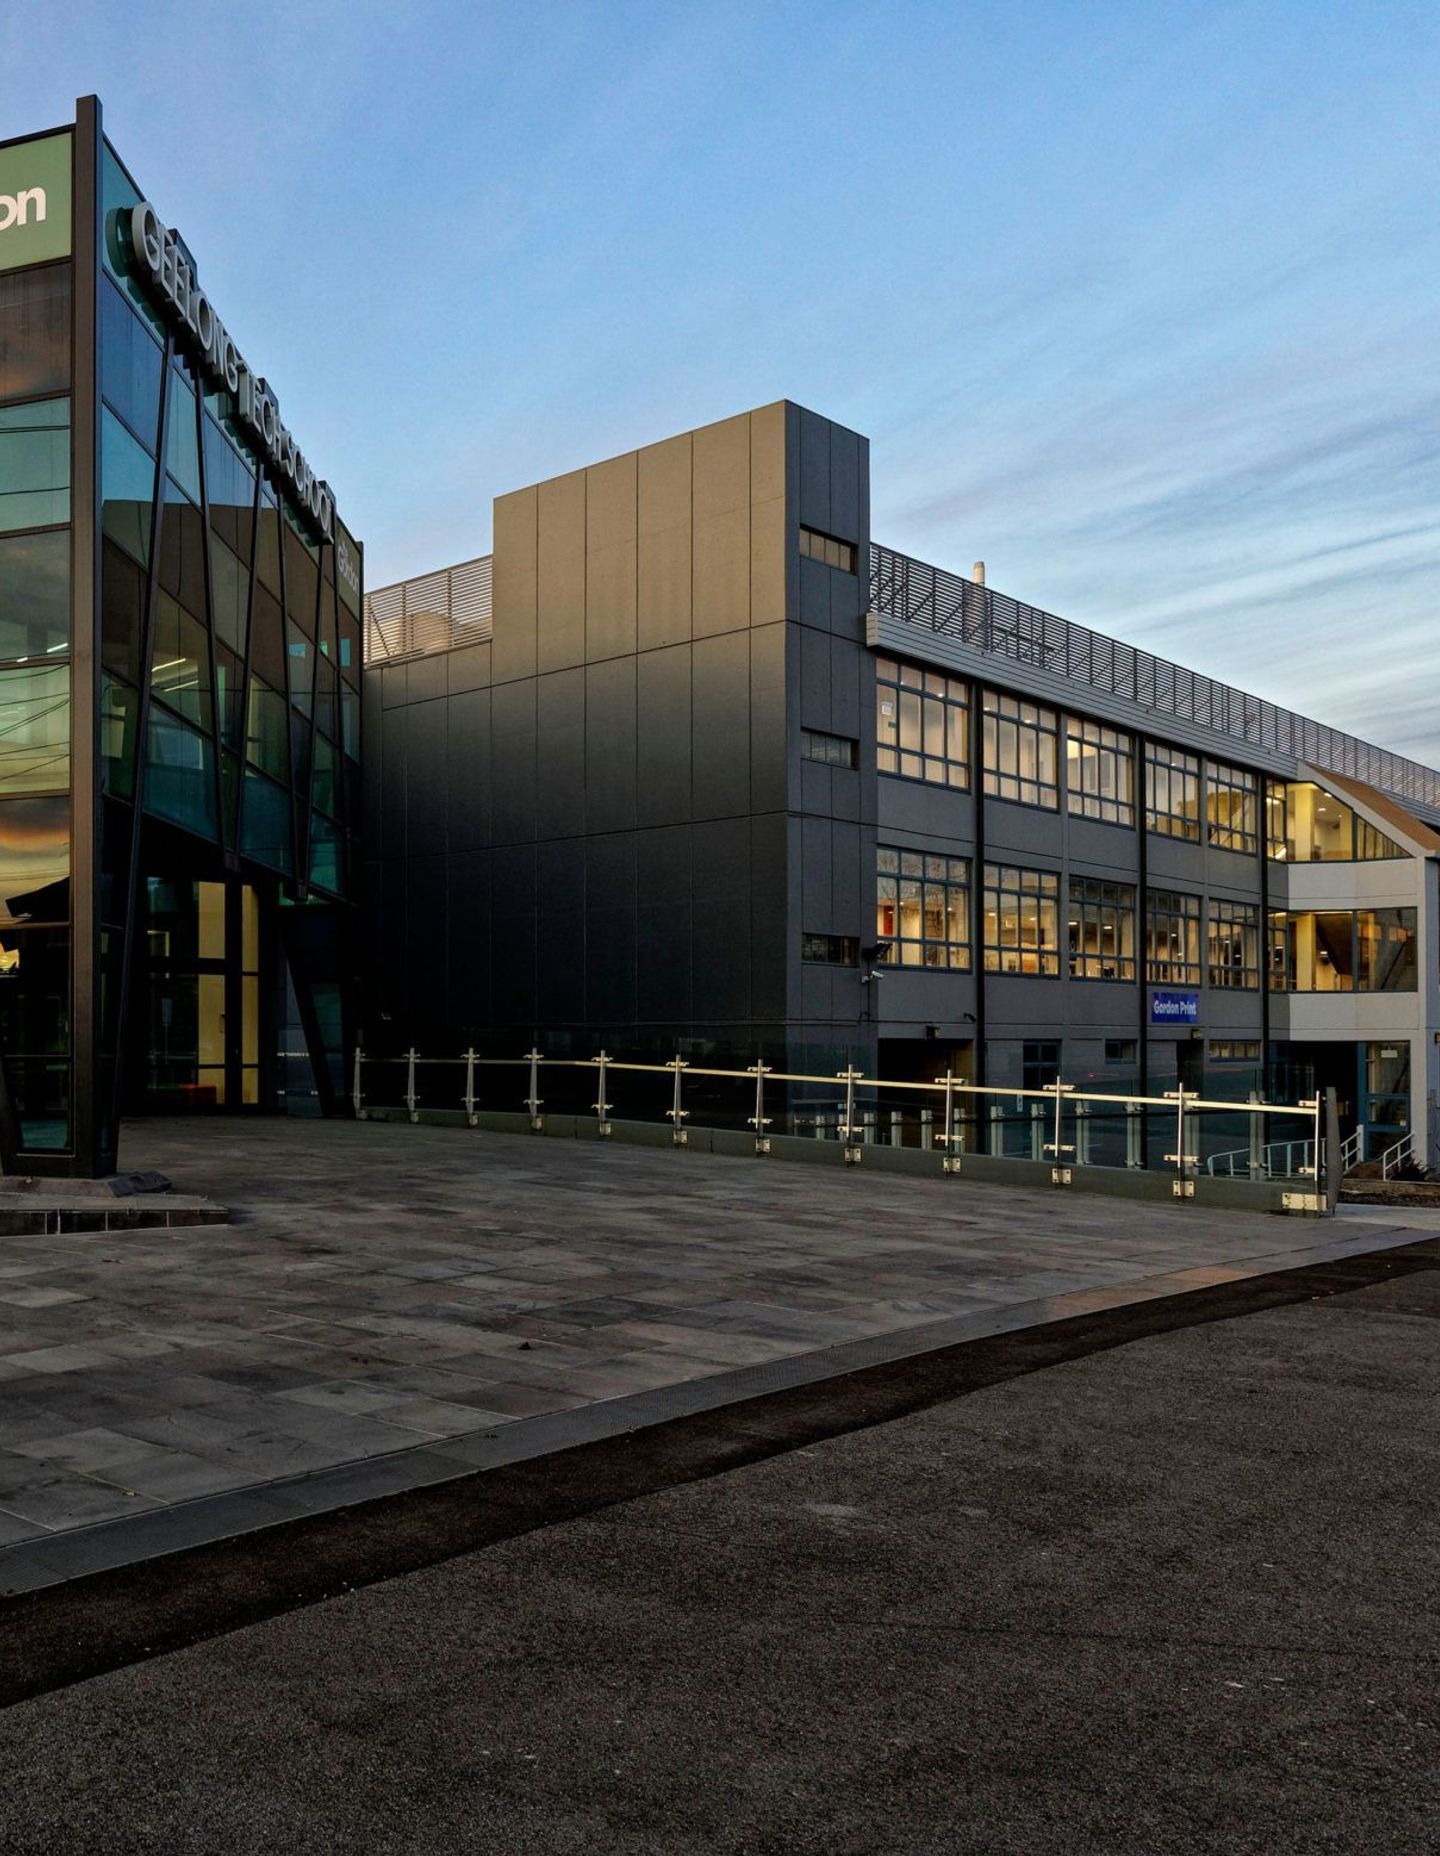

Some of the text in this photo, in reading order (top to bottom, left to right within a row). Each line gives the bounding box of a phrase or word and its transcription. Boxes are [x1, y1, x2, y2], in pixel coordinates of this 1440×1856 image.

[131, 201, 239, 393] GEELONG
[1153, 1000, 1197, 1015] Gordon Print
